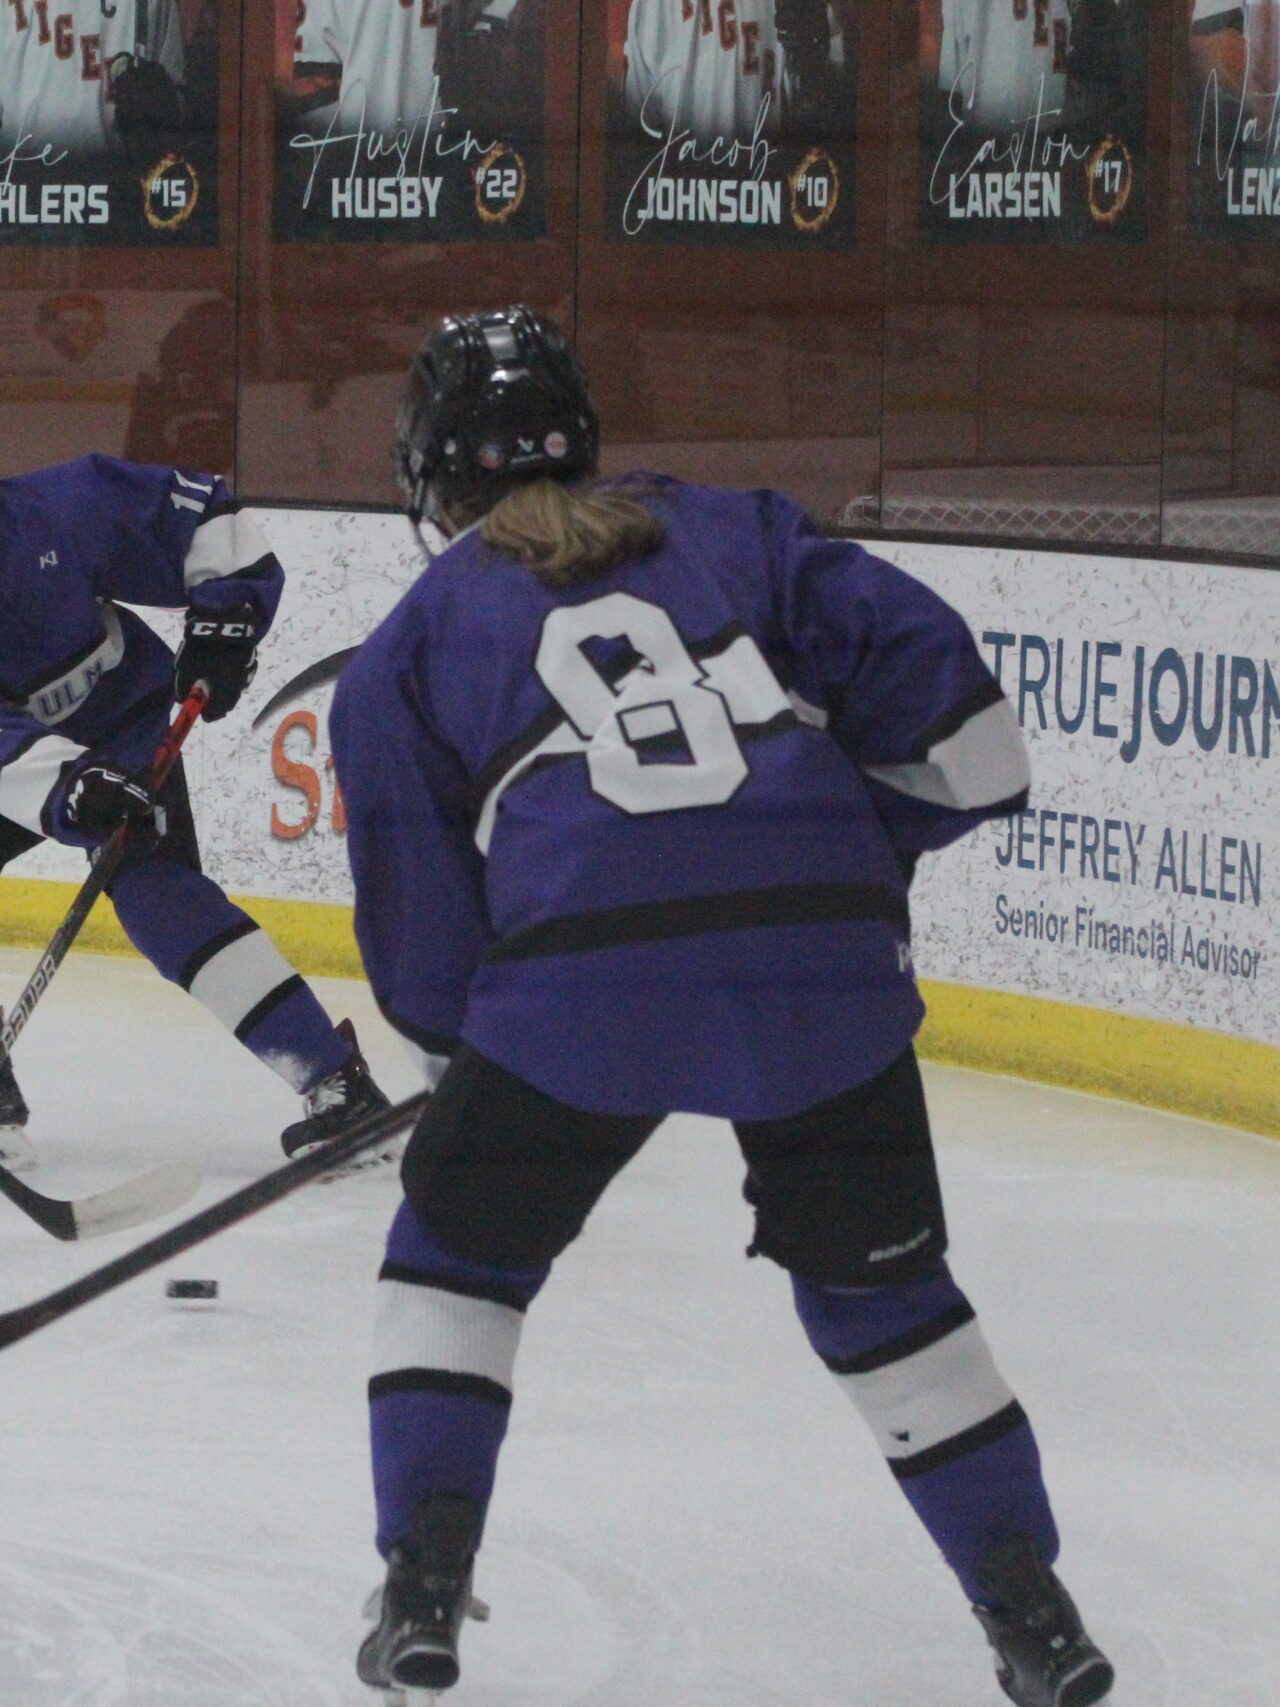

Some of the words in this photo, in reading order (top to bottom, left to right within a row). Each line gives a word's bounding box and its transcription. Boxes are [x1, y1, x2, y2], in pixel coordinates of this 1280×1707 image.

[623, 66, 778, 235] Jacob
[930, 59, 1089, 205] Easton
[151, 178, 186, 207] #15
[332, 177, 443, 218] HUSBY
[476, 167, 517, 198] #22
[797, 174, 828, 207] #10
[949, 172, 1061, 218] LARSEN
[1095, 161, 1122, 193] #17
[638, 177, 781, 224] JOHNSON
[535, 592, 749, 815] 8
[995, 808, 1146, 886] JEFFREY
[1154, 827, 1262, 907] ALLEN
[995, 894, 1068, 944] Senior
[1075, 903, 1175, 964] Financial
[1181, 925, 1262, 980] Advisor
